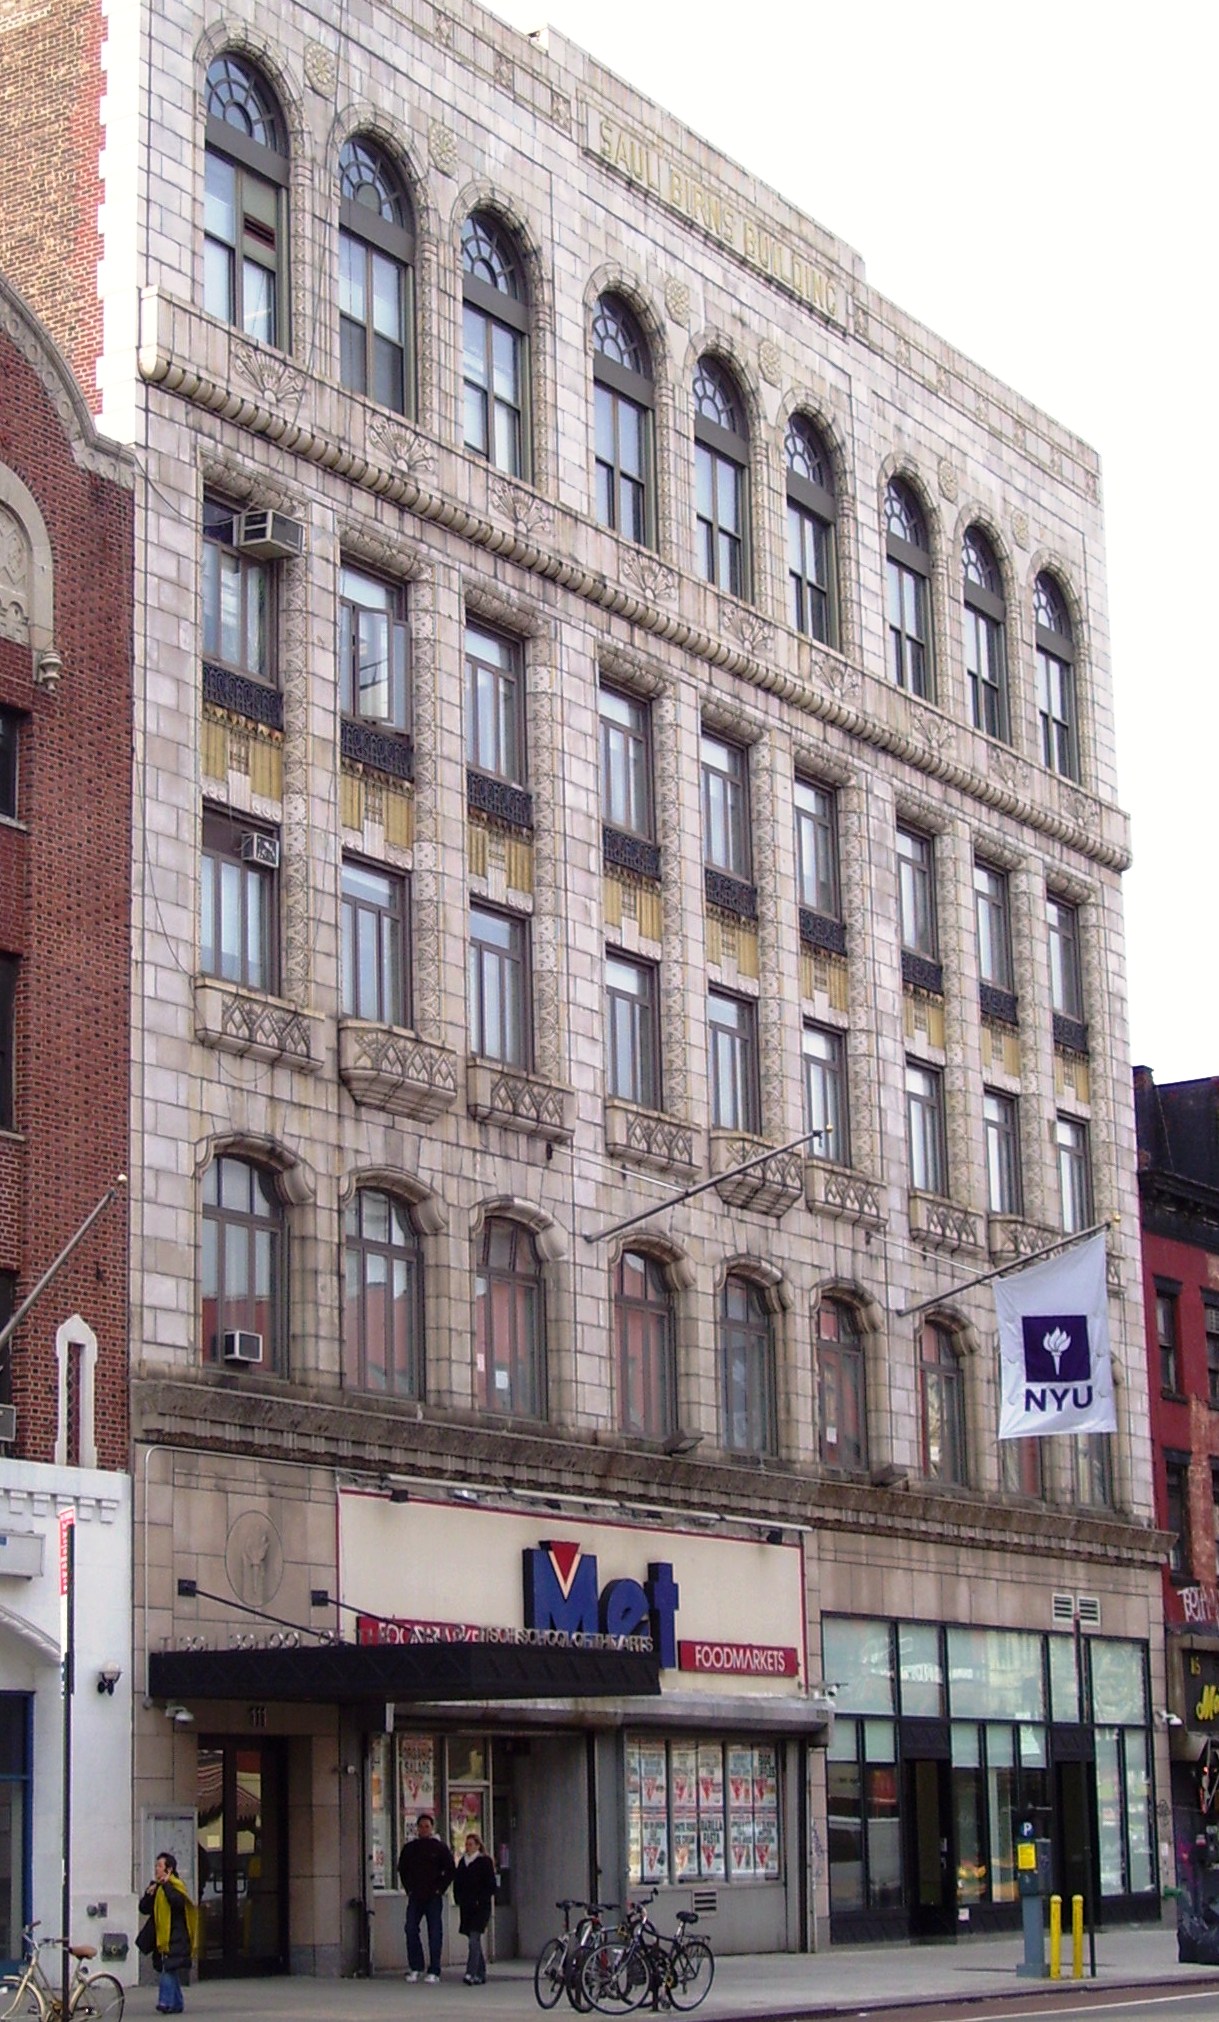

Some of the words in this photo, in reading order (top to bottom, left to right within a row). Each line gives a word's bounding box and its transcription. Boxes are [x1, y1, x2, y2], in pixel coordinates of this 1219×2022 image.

[600, 119, 660, 192] SAUL
[669, 163, 735, 243] BIRNS
[743, 221, 839, 319] BUILDING
[1025, 1385, 1094, 1413] NYU
[523, 1540, 679, 1669] Met
[516, 1628, 572, 1648] SCHOOL
[618, 1635, 654, 1652] ARTS
[694, 1646, 786, 1672] FOODMARKETS
[1023, 1821, 1033, 1837] P
